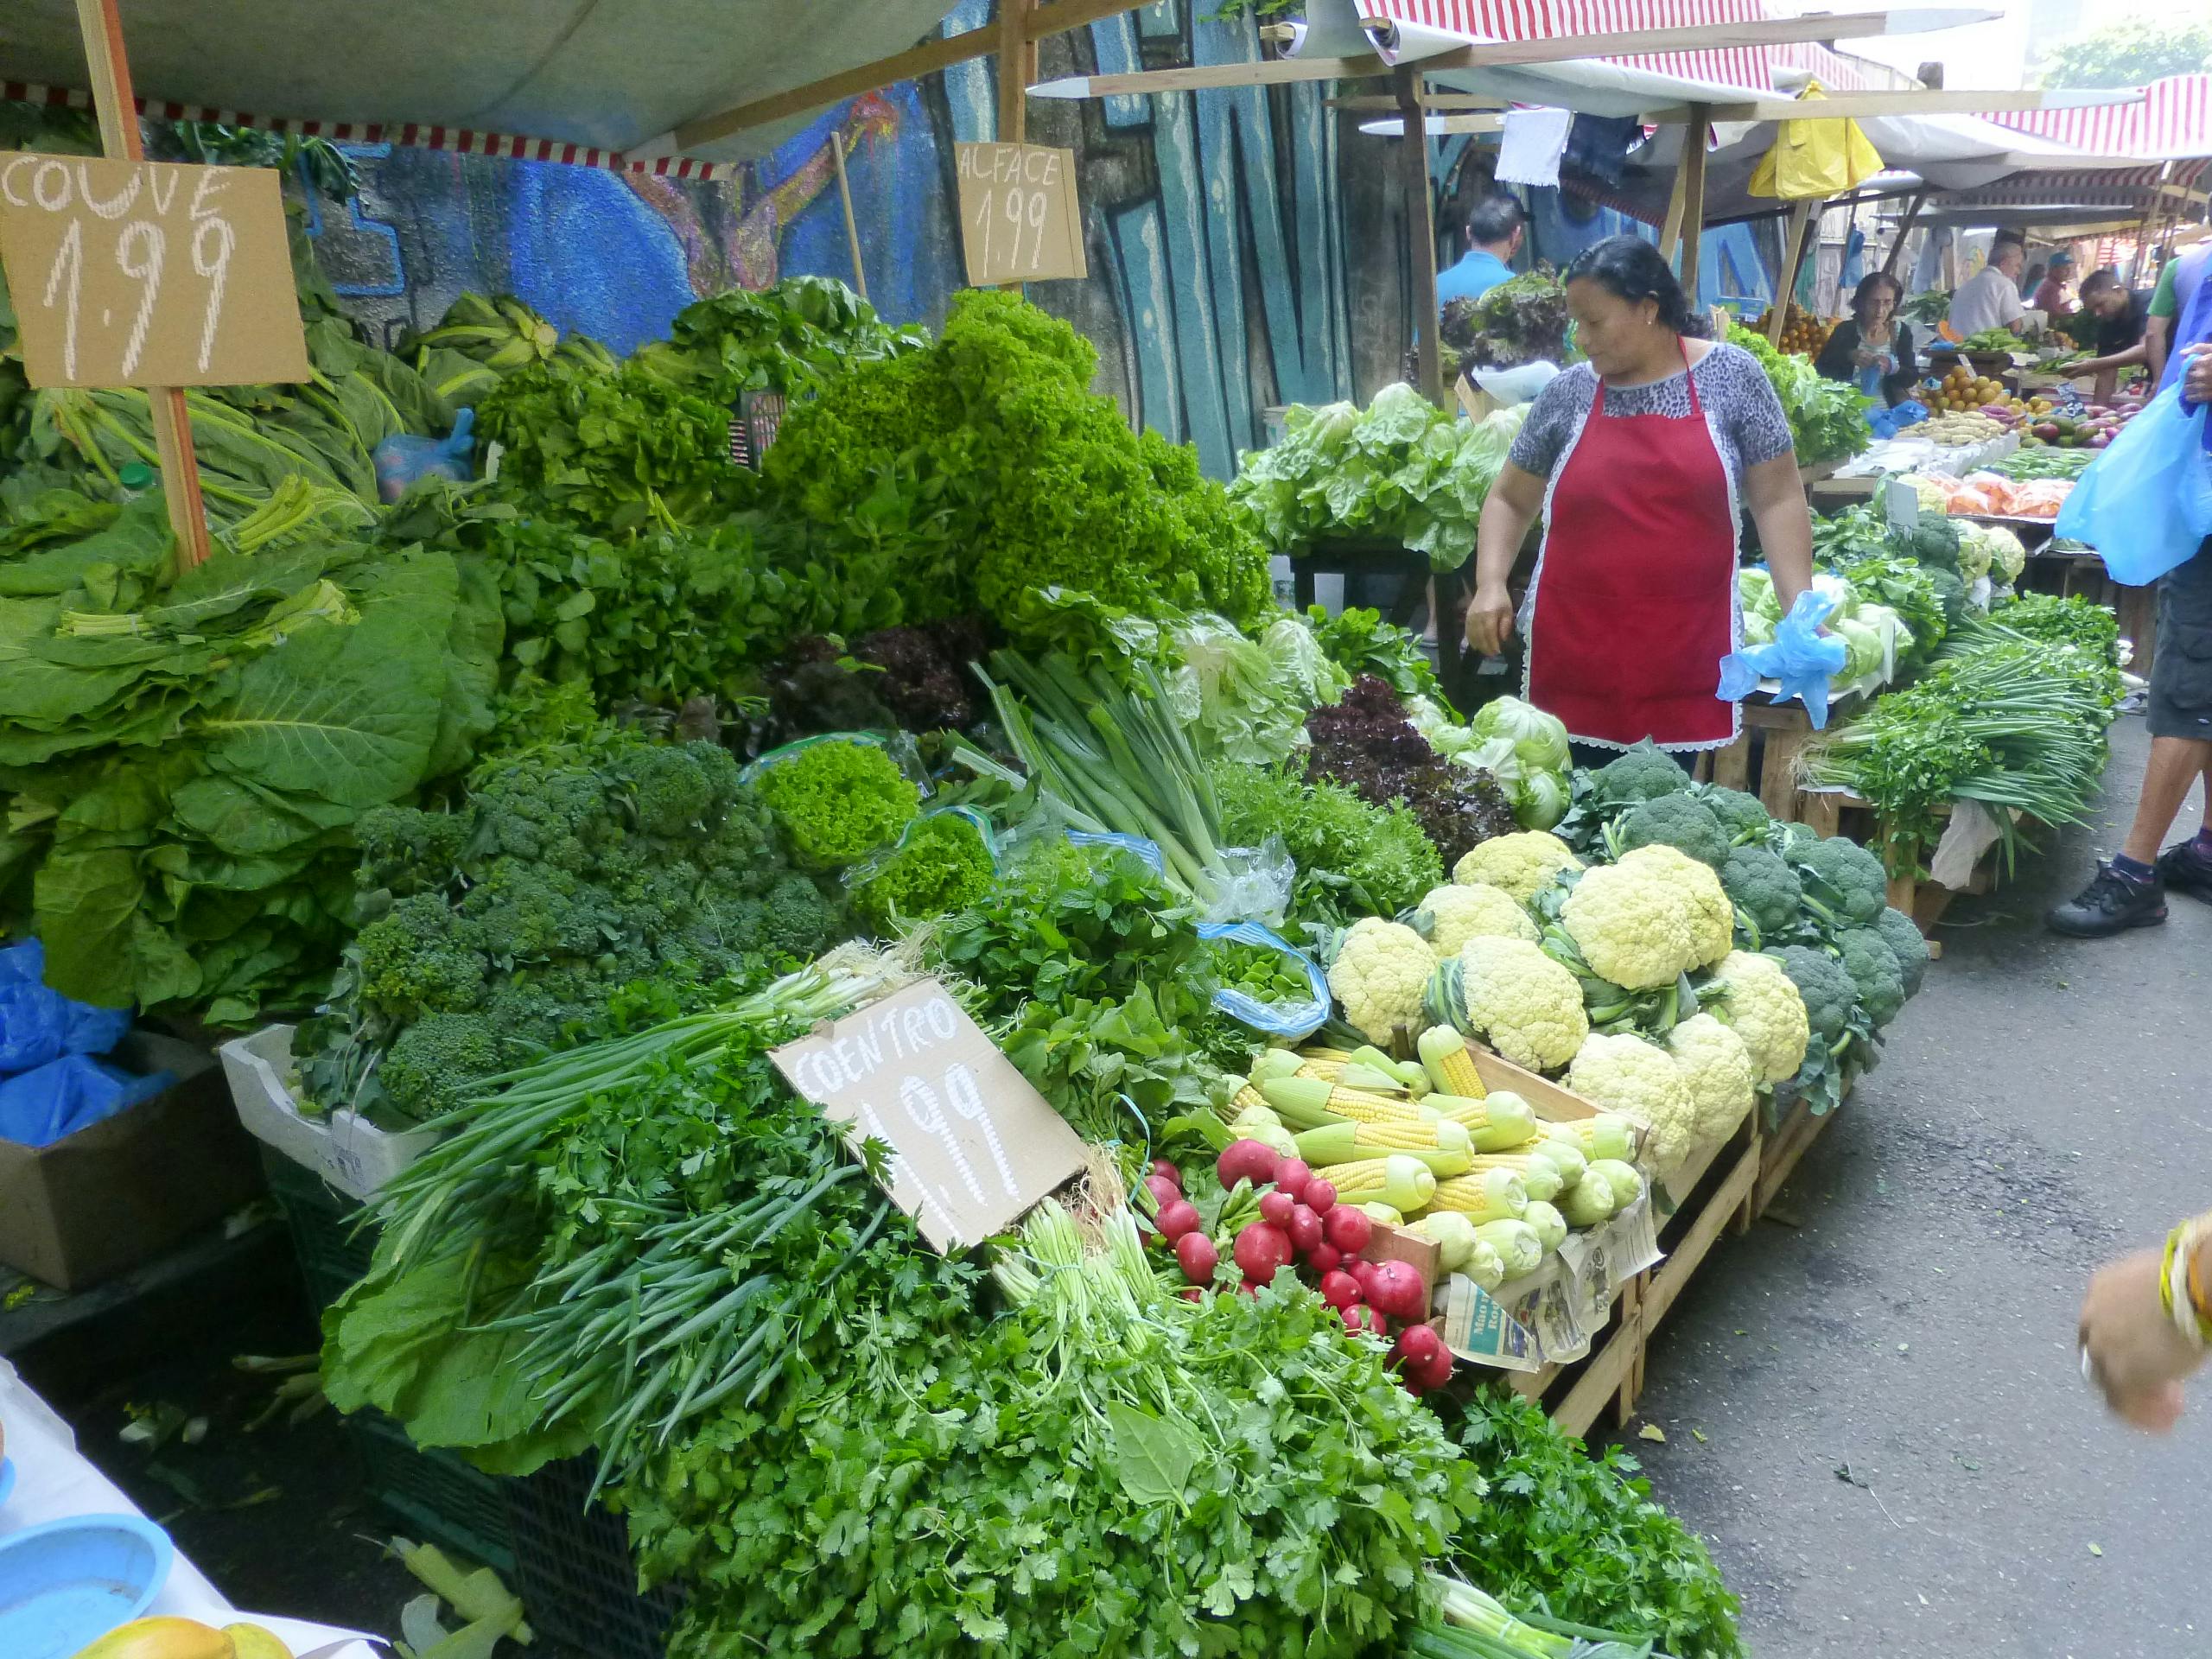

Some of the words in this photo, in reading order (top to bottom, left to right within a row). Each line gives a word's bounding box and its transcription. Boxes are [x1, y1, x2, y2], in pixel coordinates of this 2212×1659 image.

[2, 156, 232, 219] COUVE
[960, 146, 1060, 186] ALFACE
[976, 188, 1047, 278] 1.99
[43, 217, 235, 380] 1.99
[794, 997, 958, 1098] COENTRO
